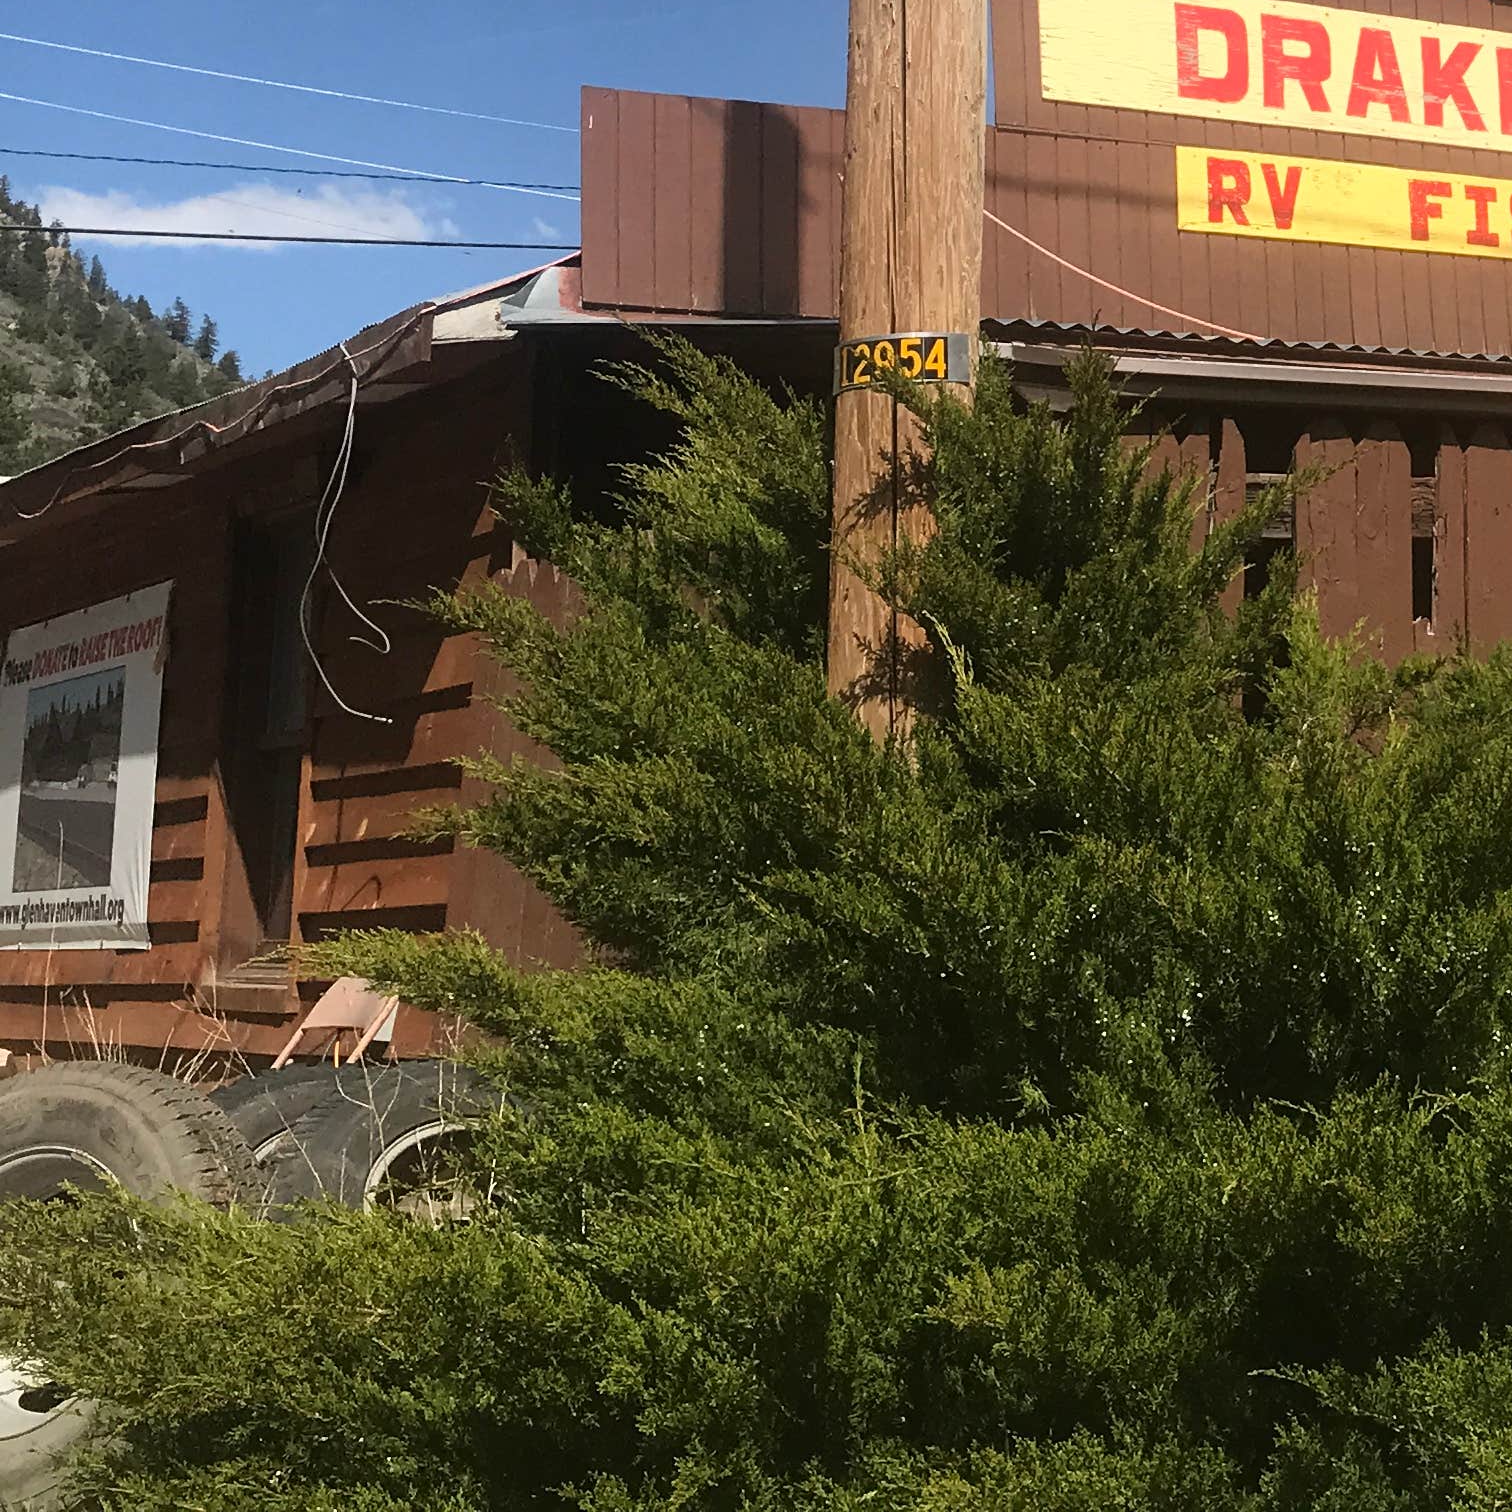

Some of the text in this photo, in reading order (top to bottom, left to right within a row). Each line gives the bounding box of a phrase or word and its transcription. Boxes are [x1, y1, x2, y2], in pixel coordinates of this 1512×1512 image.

[1207, 157, 1302, 230] RV
[4, 616, 163, 686] Please DONATE to RAISE THE ROOF!
